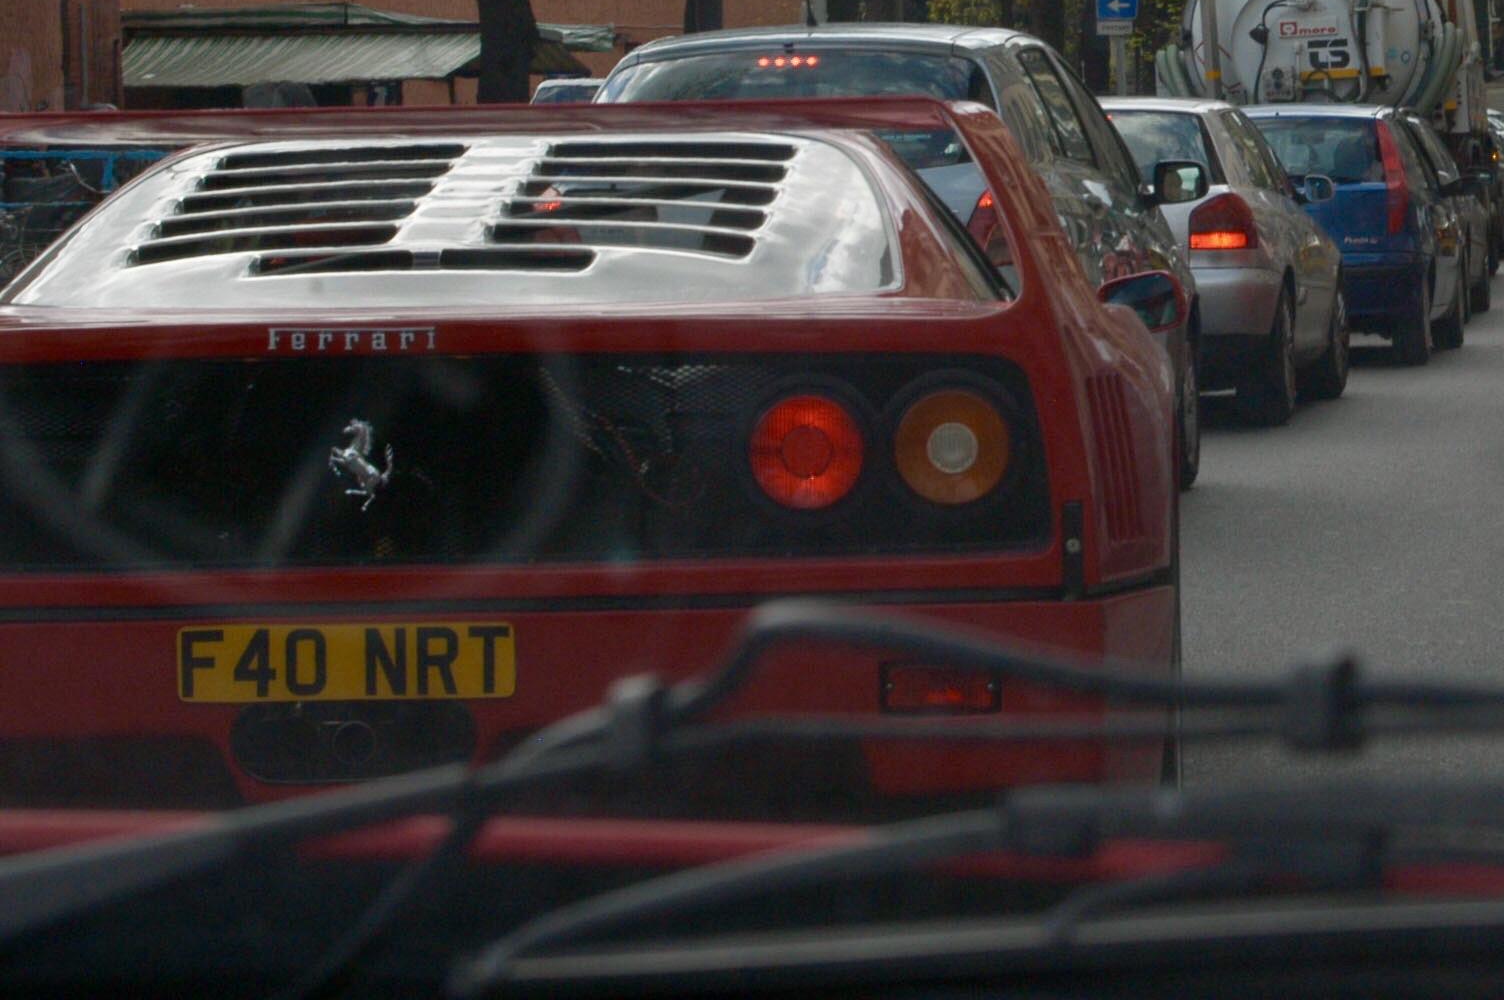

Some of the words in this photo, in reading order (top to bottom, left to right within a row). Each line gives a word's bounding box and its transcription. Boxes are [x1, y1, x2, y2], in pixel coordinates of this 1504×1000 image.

[1299, 26, 1336, 34] moro
[267, 326, 436, 350] Ferrari
[180, 627, 327, 698] F40
[365, 626, 511, 696] NRT
